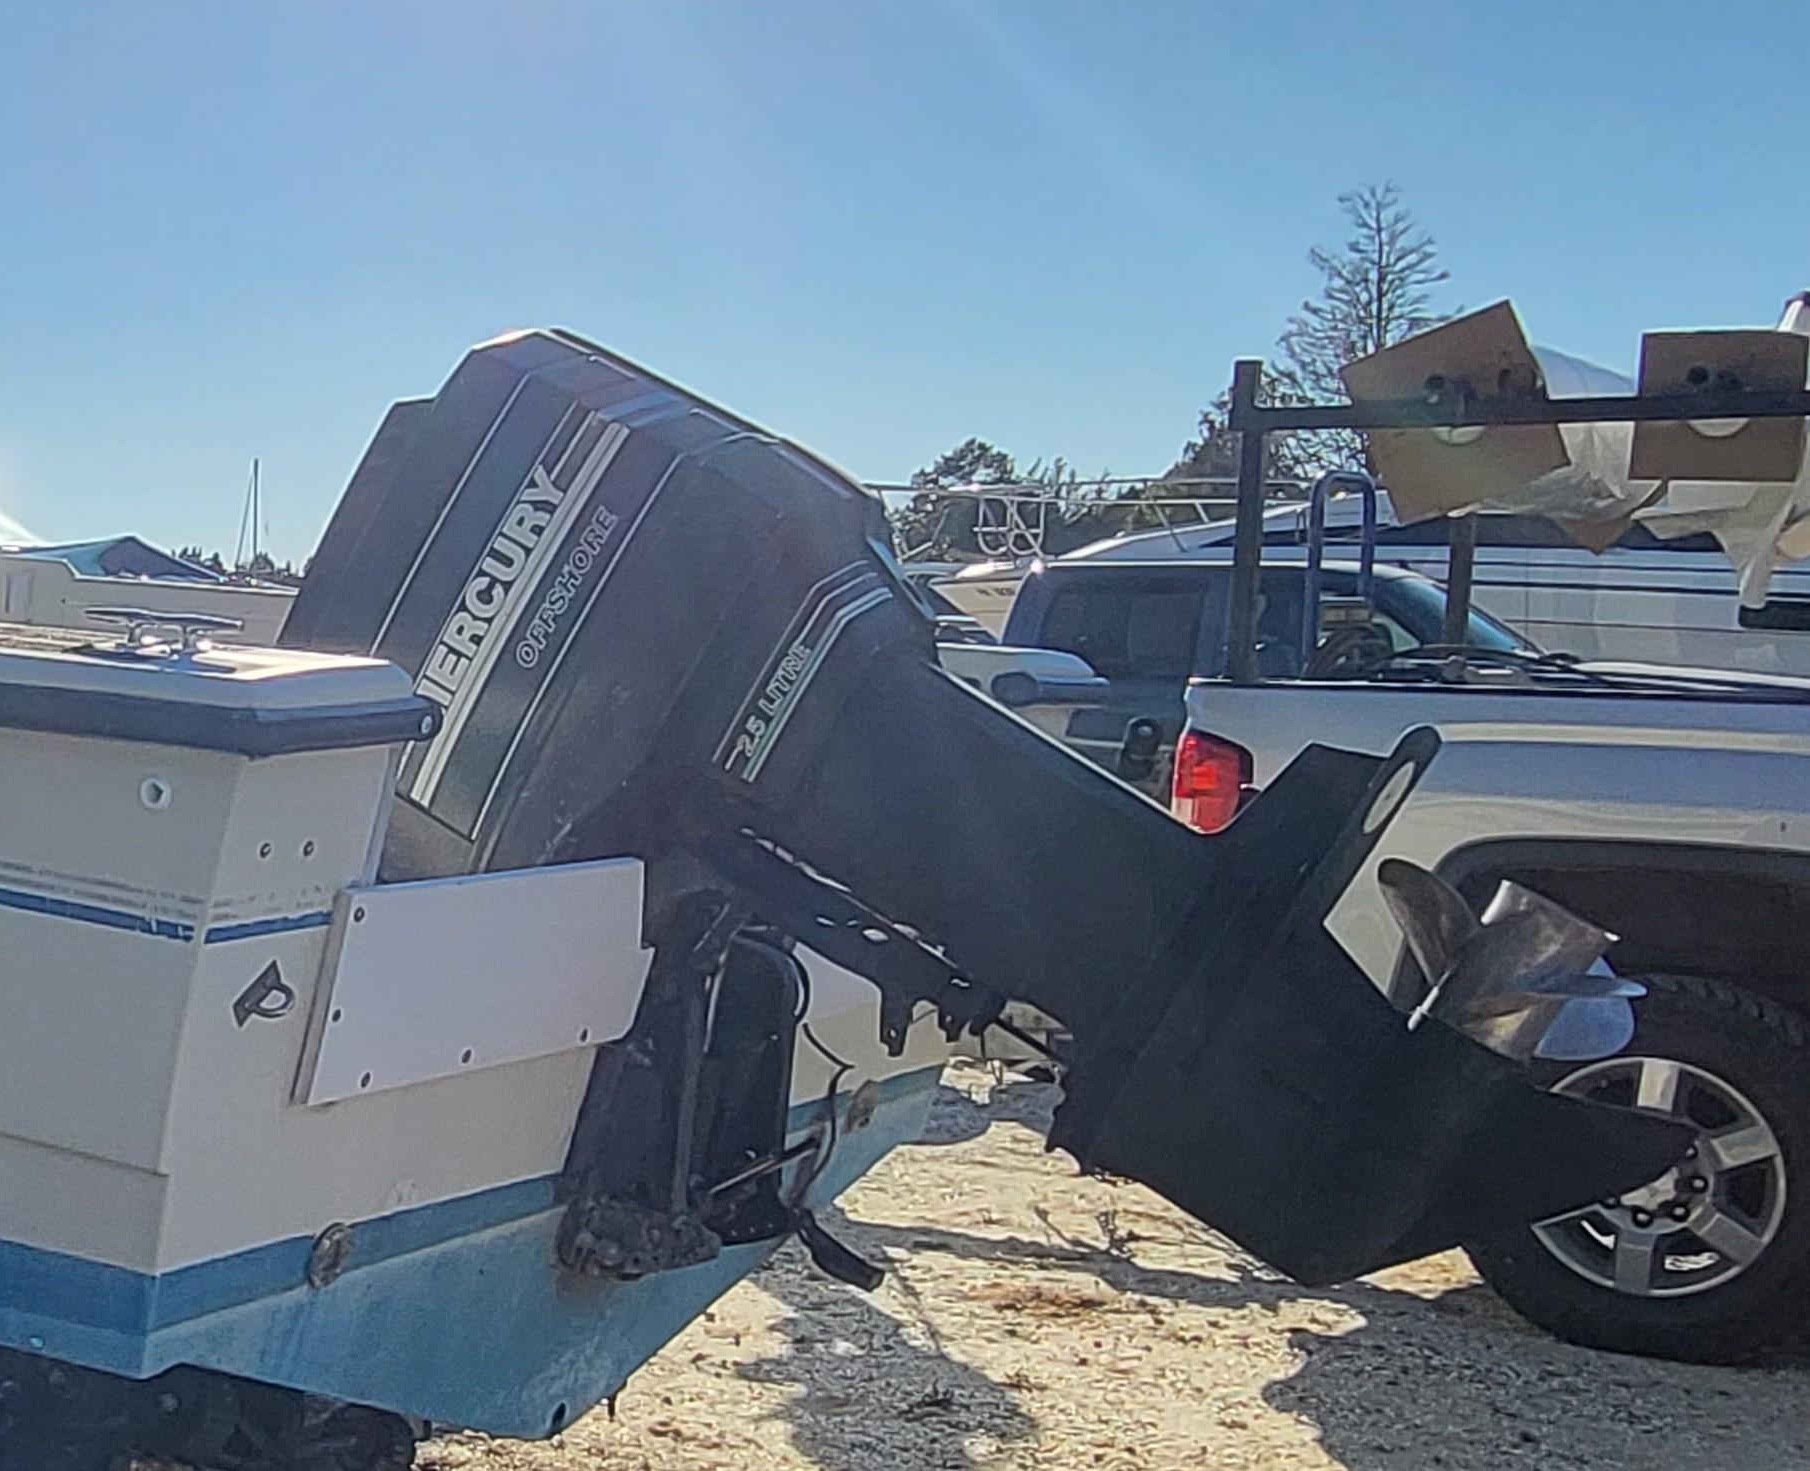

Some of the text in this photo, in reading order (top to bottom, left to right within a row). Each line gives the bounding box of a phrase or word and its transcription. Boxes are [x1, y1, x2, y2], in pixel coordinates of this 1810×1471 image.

[516, 505, 618, 669] OFFSHORE
[737, 645, 812, 757] 2.5 LITRE
